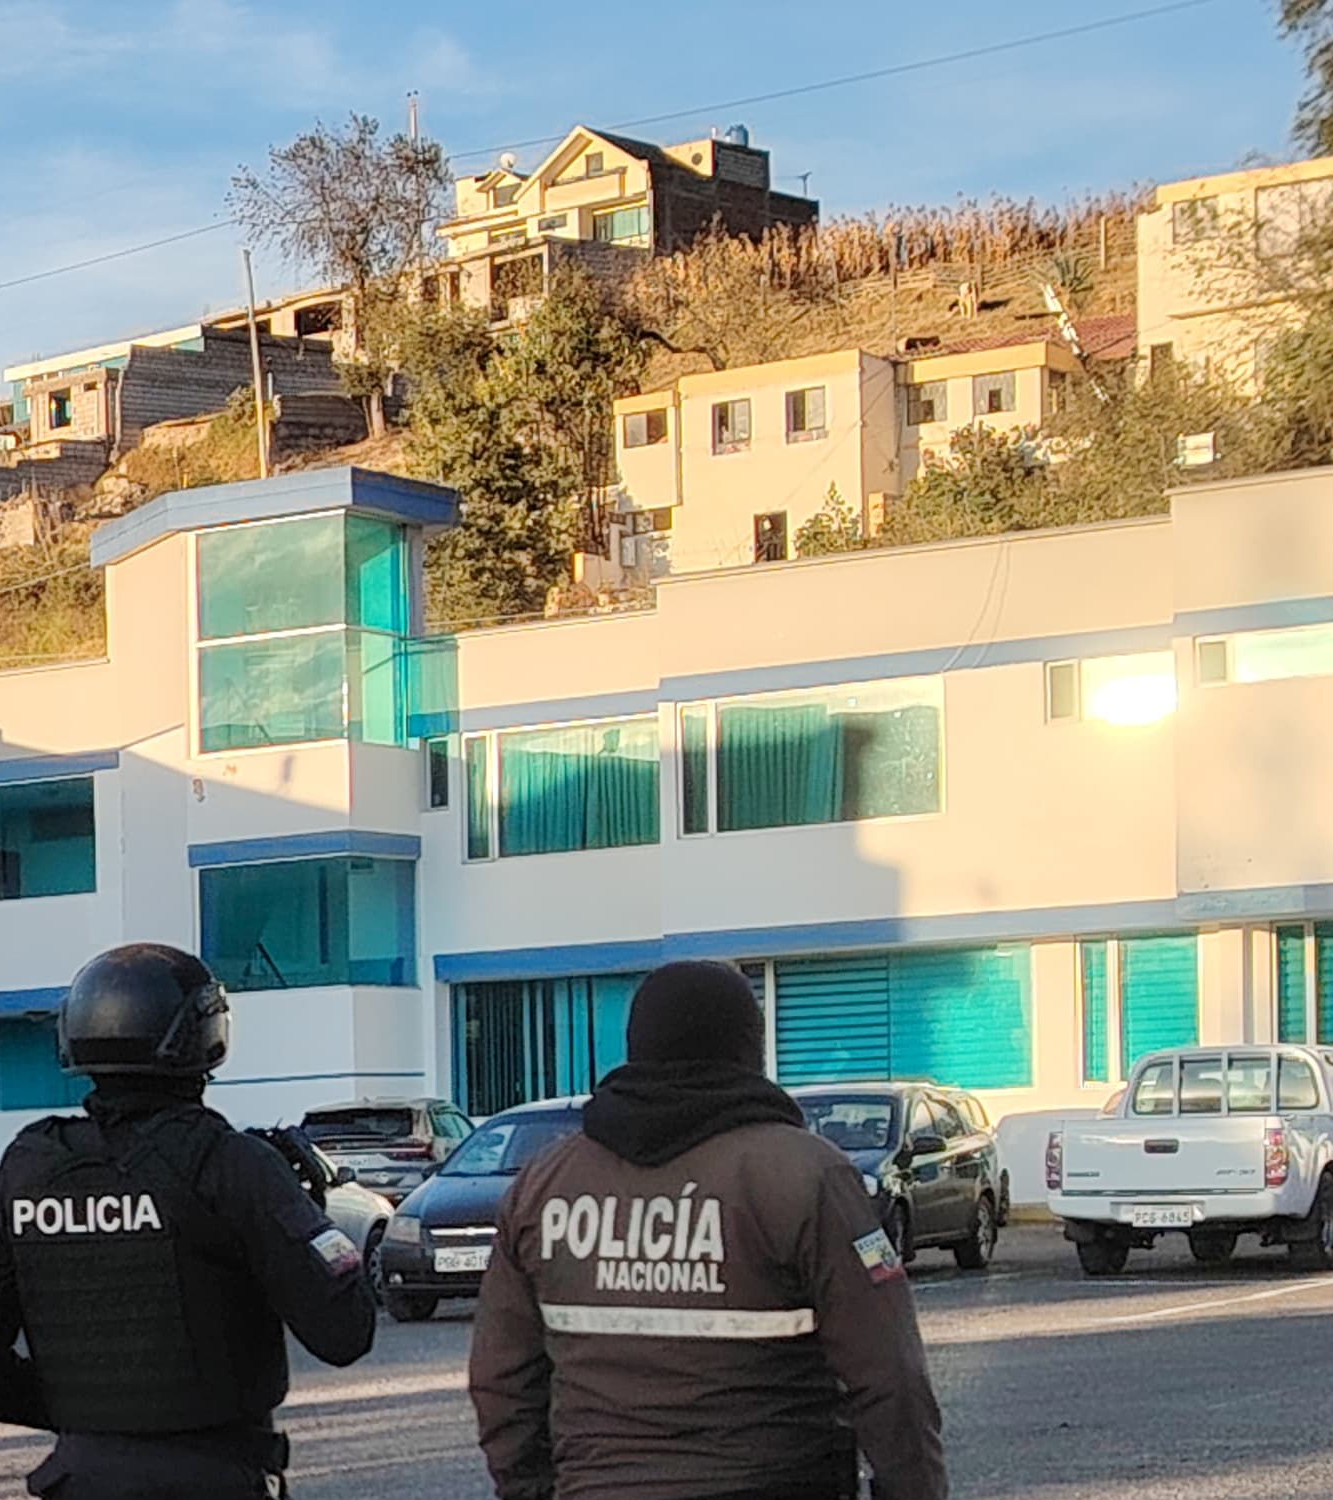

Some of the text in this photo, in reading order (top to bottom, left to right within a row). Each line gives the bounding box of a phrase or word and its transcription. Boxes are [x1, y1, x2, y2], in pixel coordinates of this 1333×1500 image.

[13, 1194, 162, 1236] POLICIA
[541, 1181, 724, 1262] POLICÍA
[597, 1260, 726, 1293] NACIONAL
